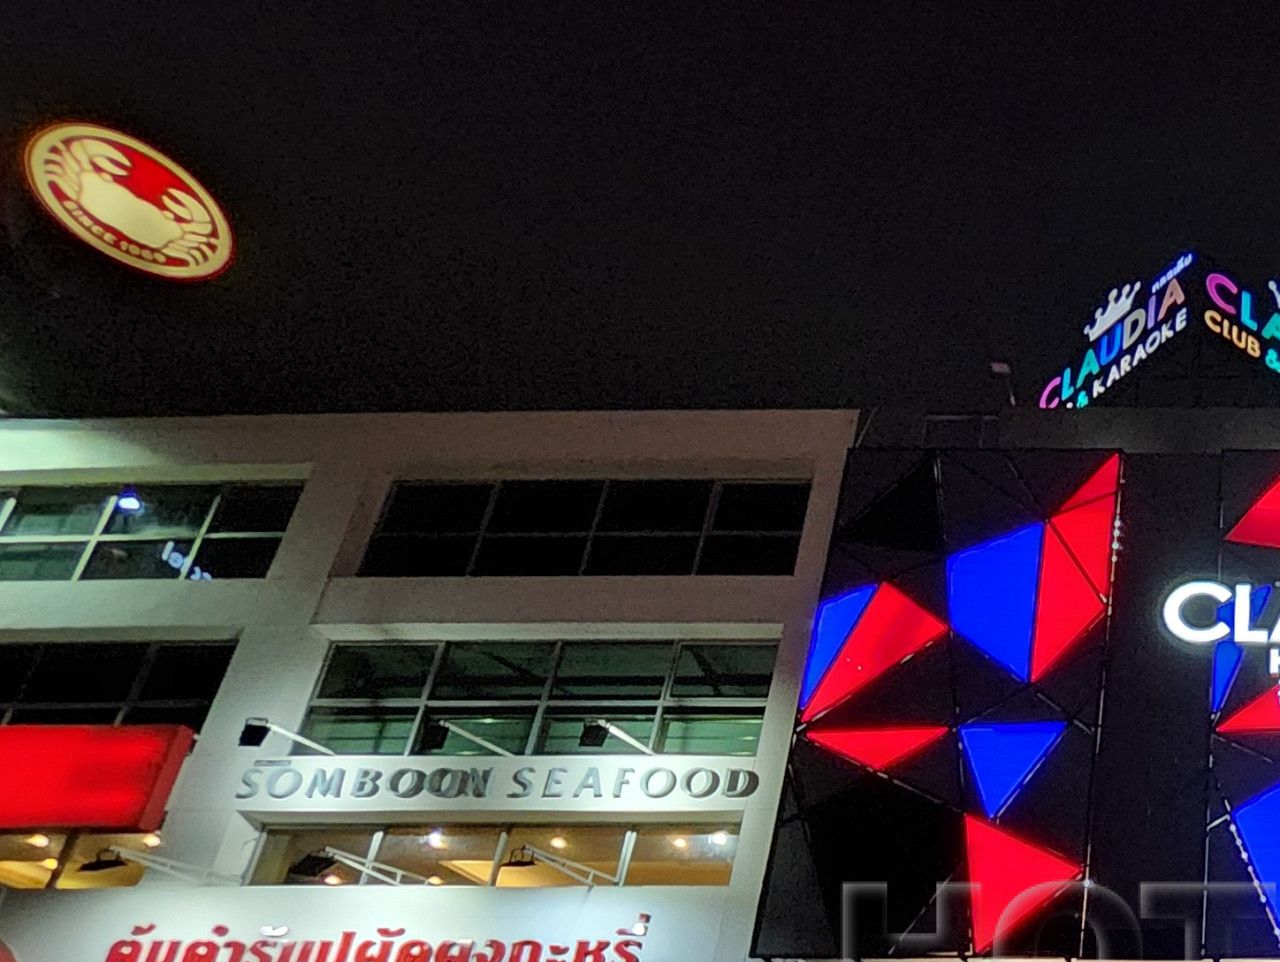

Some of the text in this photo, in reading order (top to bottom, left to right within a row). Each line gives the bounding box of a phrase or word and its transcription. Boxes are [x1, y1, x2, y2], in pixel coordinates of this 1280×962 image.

[1039, 277, 1186, 409] CLAUDIA
[1092, 307, 1188, 398] KARAOKE
[1203, 309, 1261, 358] CLUB
[234, 765, 761, 801] SOMBOON SEAFOOD
